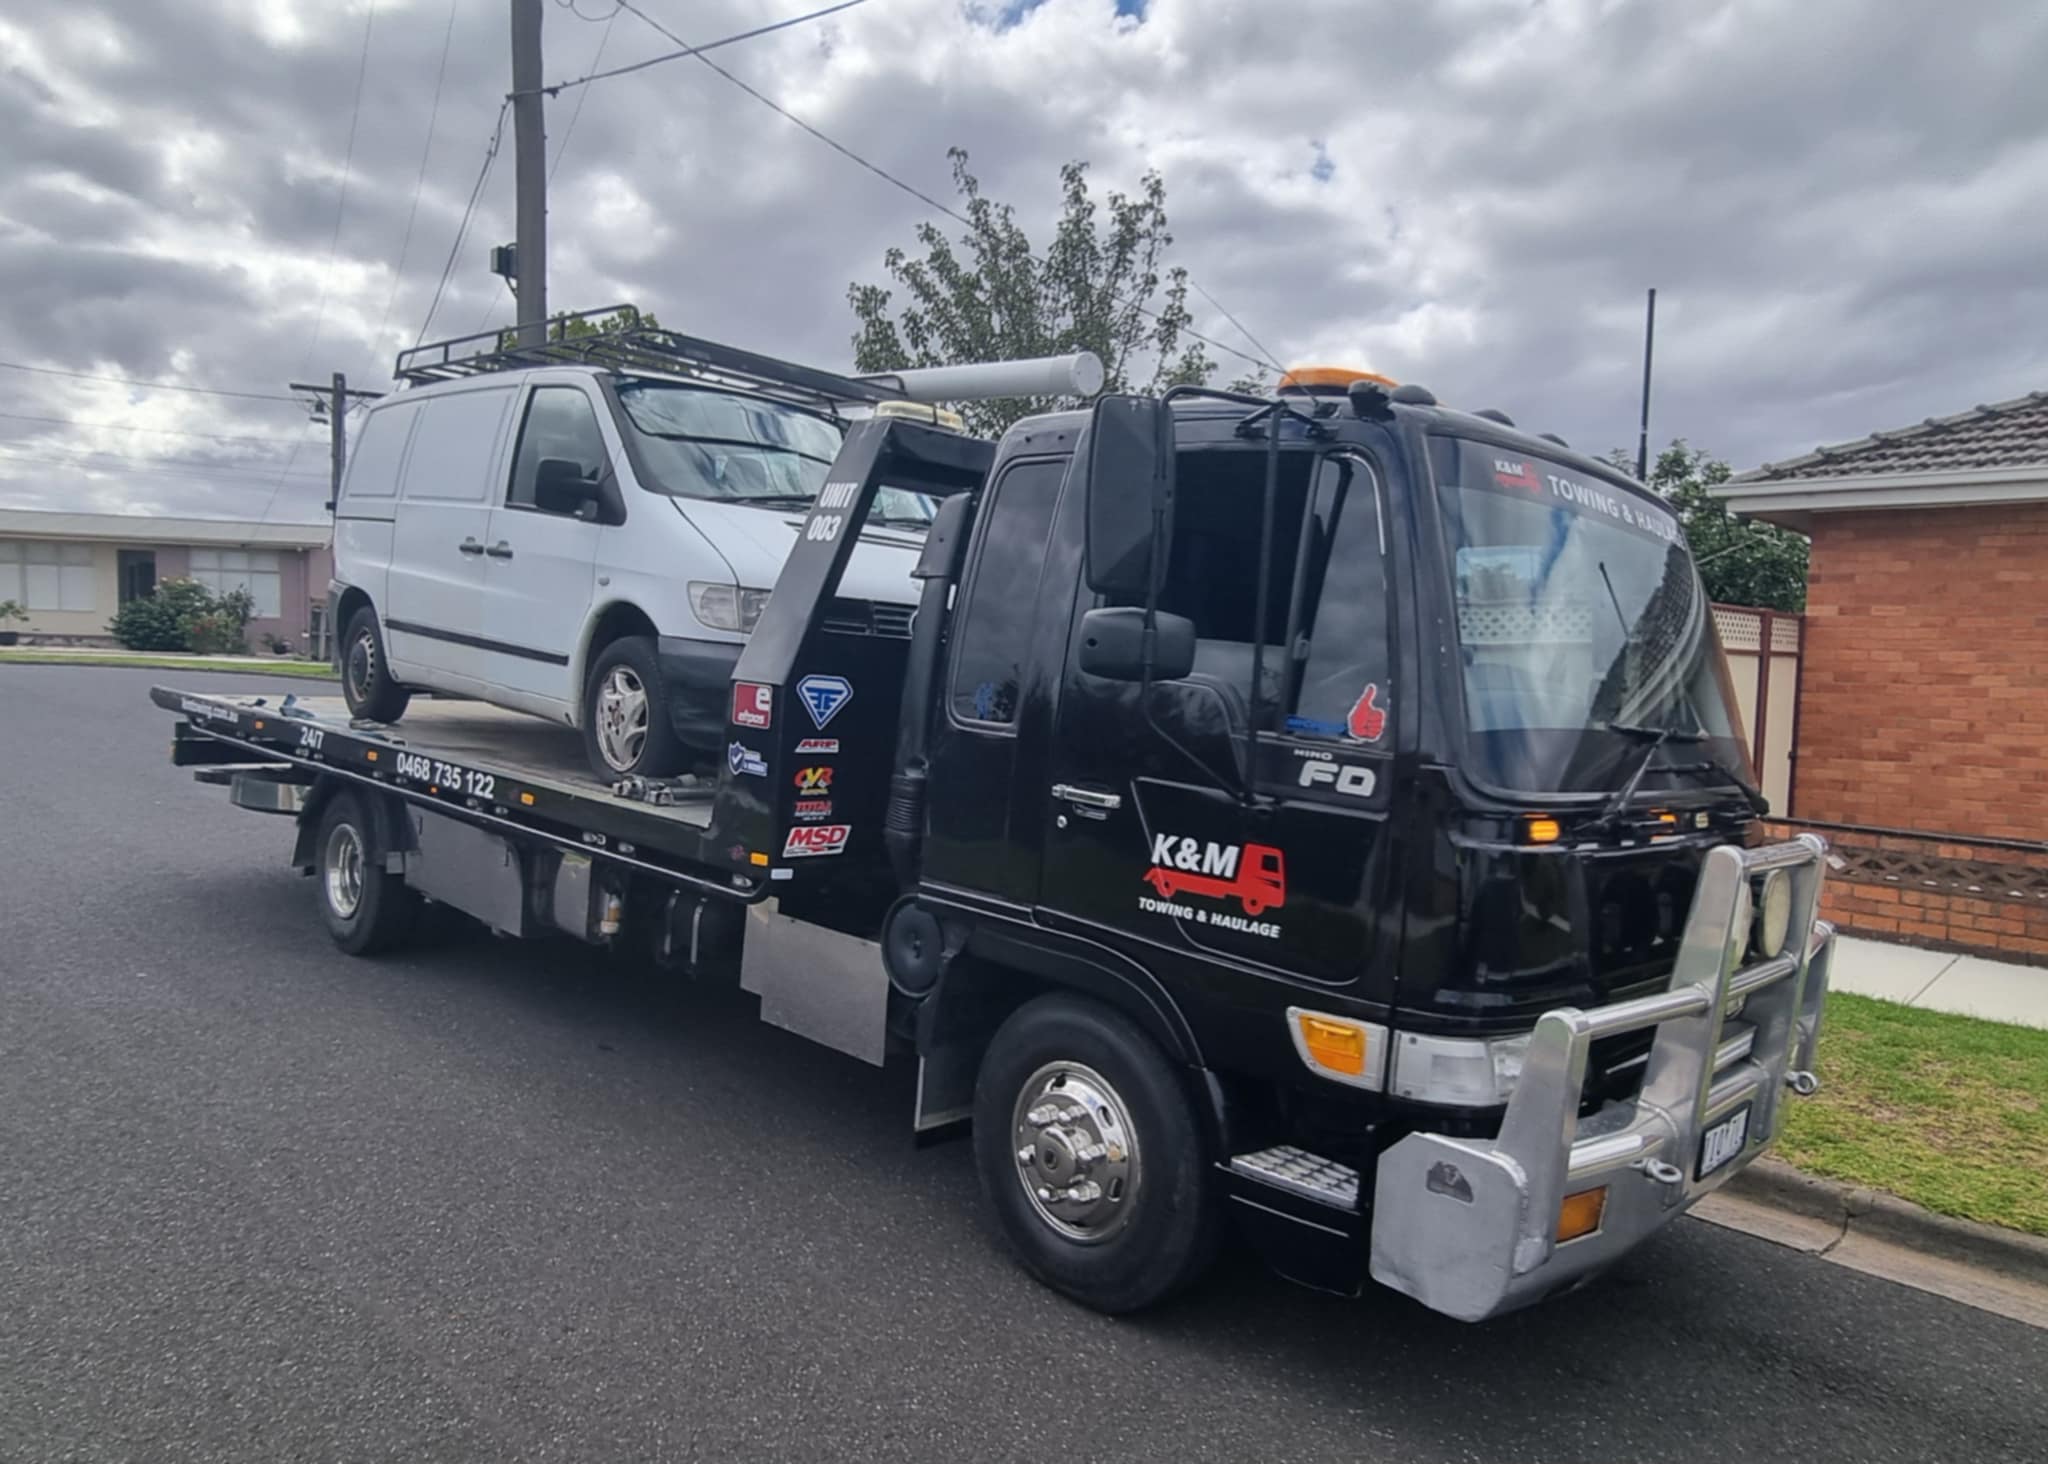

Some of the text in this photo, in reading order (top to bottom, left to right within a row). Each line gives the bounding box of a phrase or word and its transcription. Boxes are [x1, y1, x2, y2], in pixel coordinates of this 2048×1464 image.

[820, 482, 858, 508] UNIT
[1547, 475, 1686, 551] TOWING & HAUL
[807, 515, 842, 541] 003
[300, 726, 324, 749] 24/7
[801, 740, 837, 748] ARP
[1293, 749, 1333, 761] HINO
[396, 752, 495, 799] 0468 735 122
[1298, 760, 1376, 797] FD
[788, 827, 848, 847] MSD
[1151, 833, 1240, 878] K&M
[1138, 896, 1281, 939] TOWING & HAULAGE
